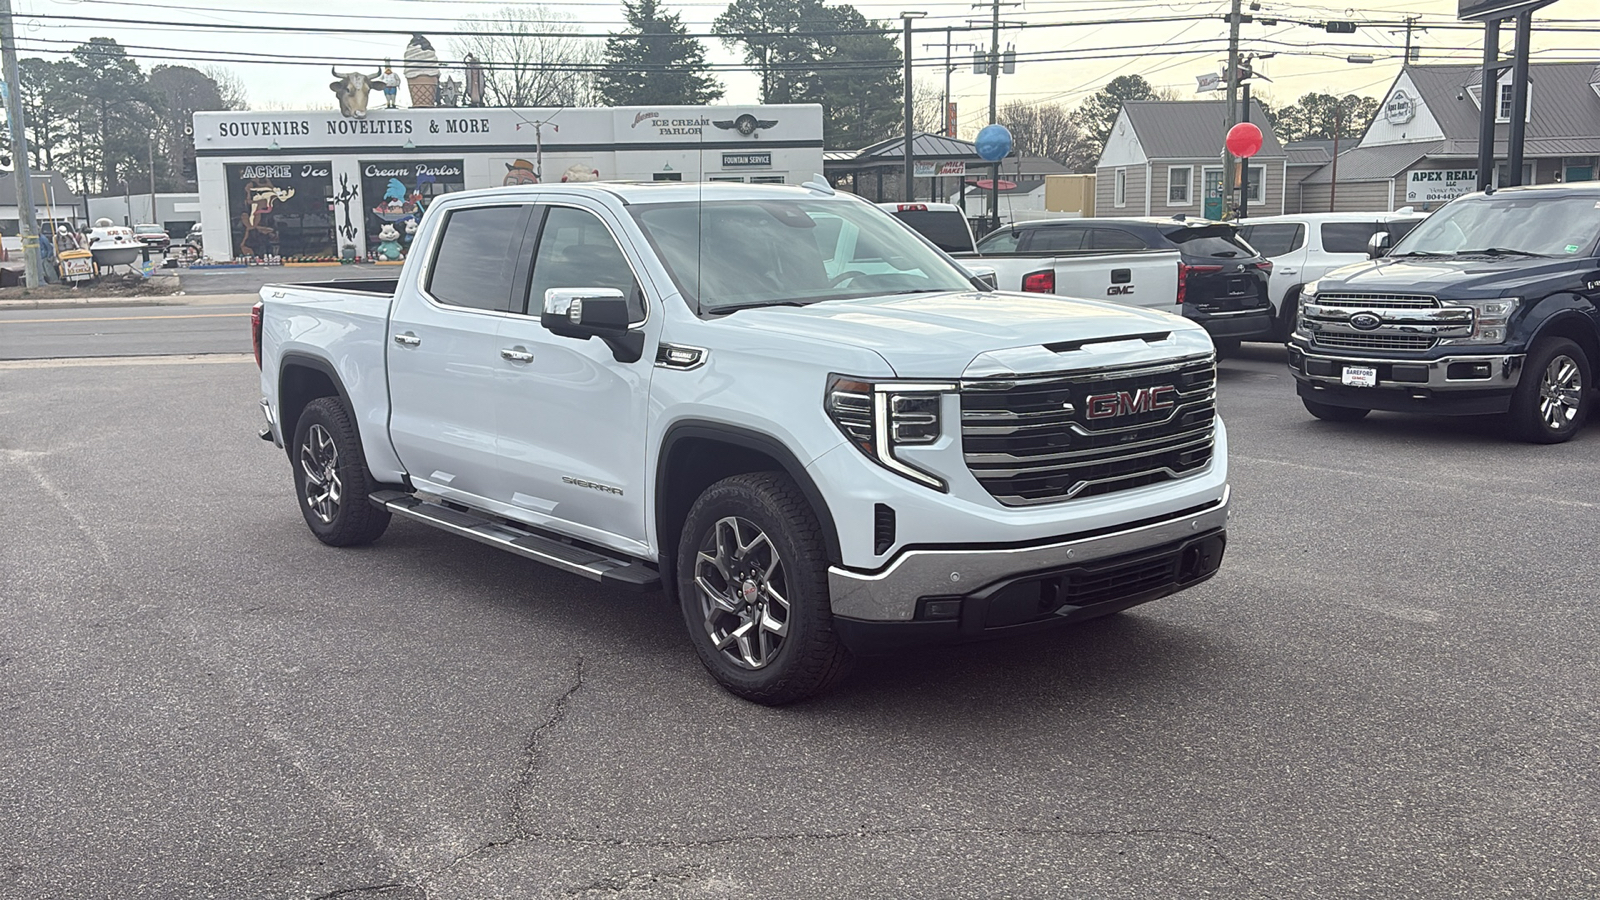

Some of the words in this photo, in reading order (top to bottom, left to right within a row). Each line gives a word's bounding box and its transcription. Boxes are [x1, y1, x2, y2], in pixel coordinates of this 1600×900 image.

[219, 121, 310, 137] SOUVENIRS
[327, 119, 413, 135] NOVELTIES
[429, 120, 440, 134] &
[446, 119, 490, 133] MORE
[651, 119, 670, 127] ICE
[671, 118, 710, 127] CREAM
[659, 127, 702, 136] PARLOR
[724, 156, 749, 164] FOUNTAIN
[749, 155, 770, 164] SERVICE
[243, 165, 292, 179] ACME
[301, 164, 329, 177] Ice
[364, 164, 410, 177] Cream
[415, 163, 460, 177] Parlor
[1412, 172, 1442, 181] APEX
[1446, 170, 1477, 180] REAL
[1107, 285, 1135, 296] GMC
[1086, 384, 1175, 420] GMC
[561, 475, 624, 496] SIERRA
